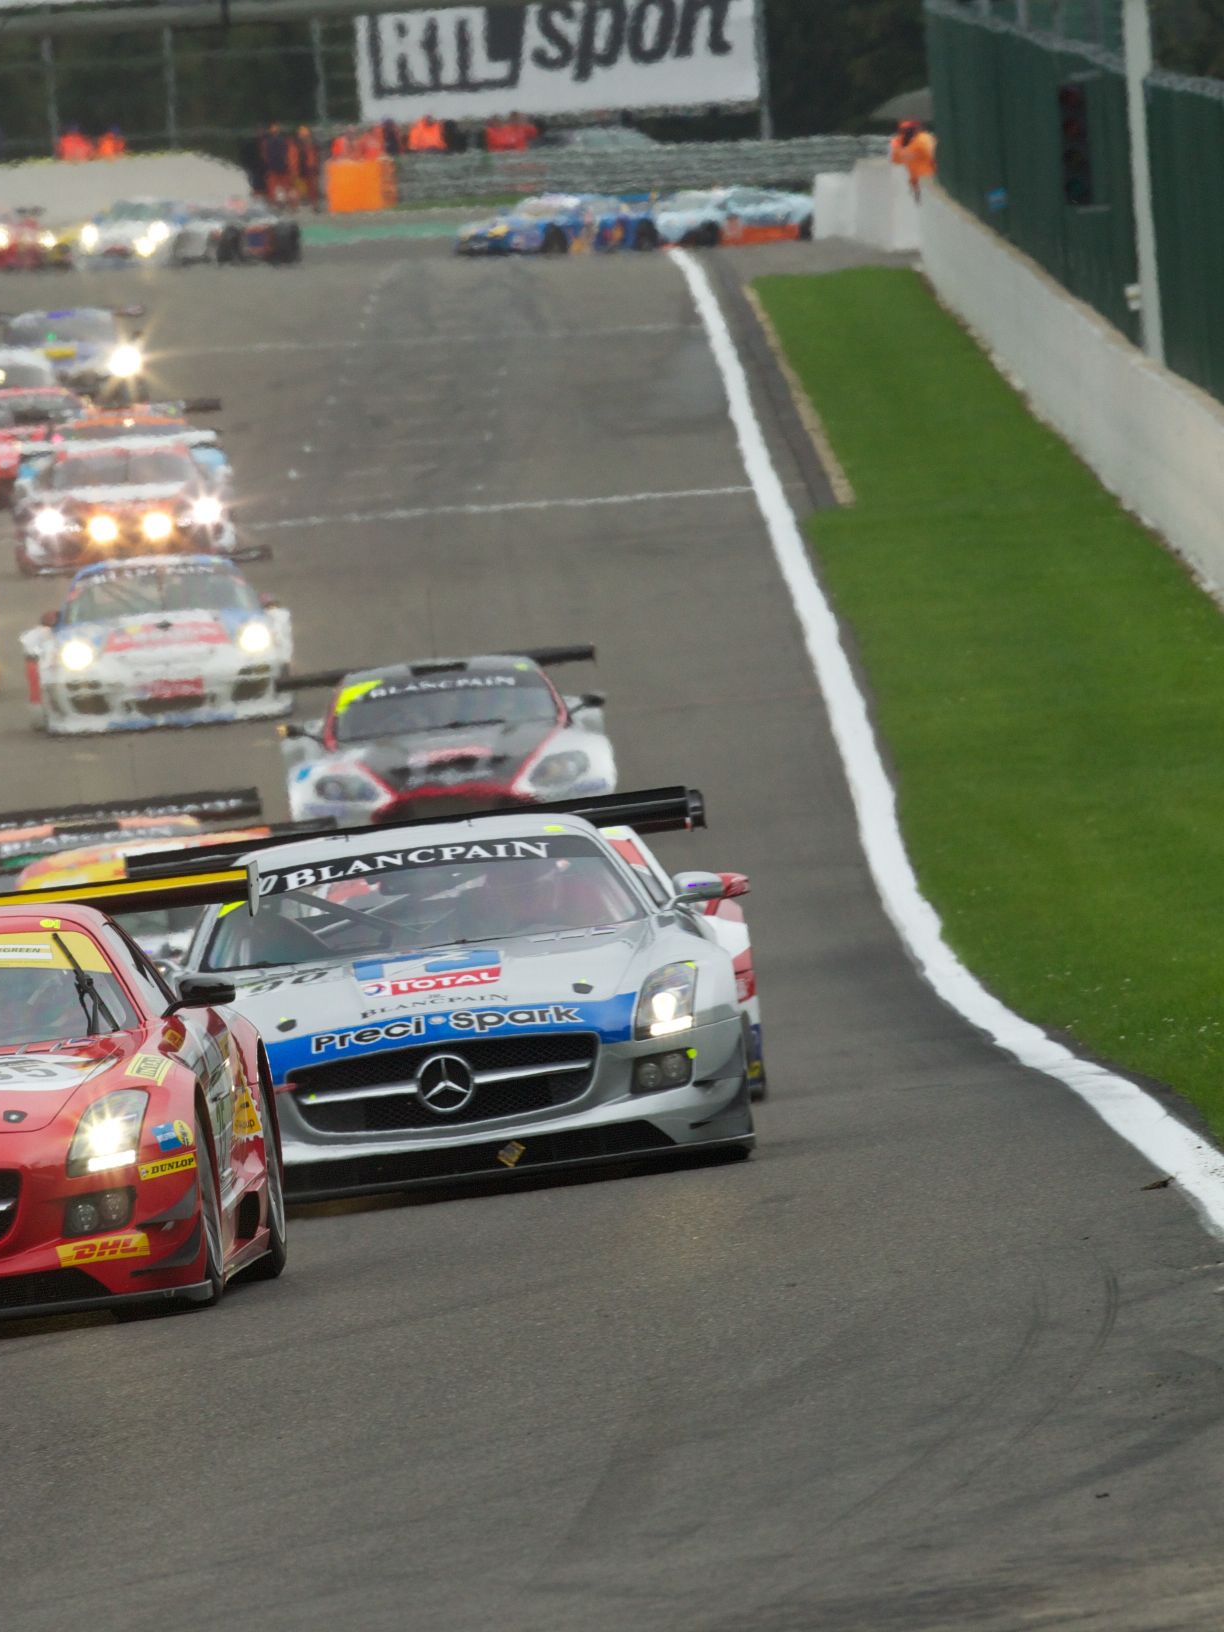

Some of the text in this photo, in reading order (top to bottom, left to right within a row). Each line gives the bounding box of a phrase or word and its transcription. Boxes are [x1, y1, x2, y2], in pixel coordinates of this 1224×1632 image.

[283, 841, 550, 892] BLANCPAIN
[394, 972, 501, 991] TOTAL
[360, 993, 509, 1019] BLANCPAIN
[449, 1005, 585, 1032] Spark
[151, 1157, 194, 1175] DUNLOP
[72, 1238, 139, 1260] DHL
